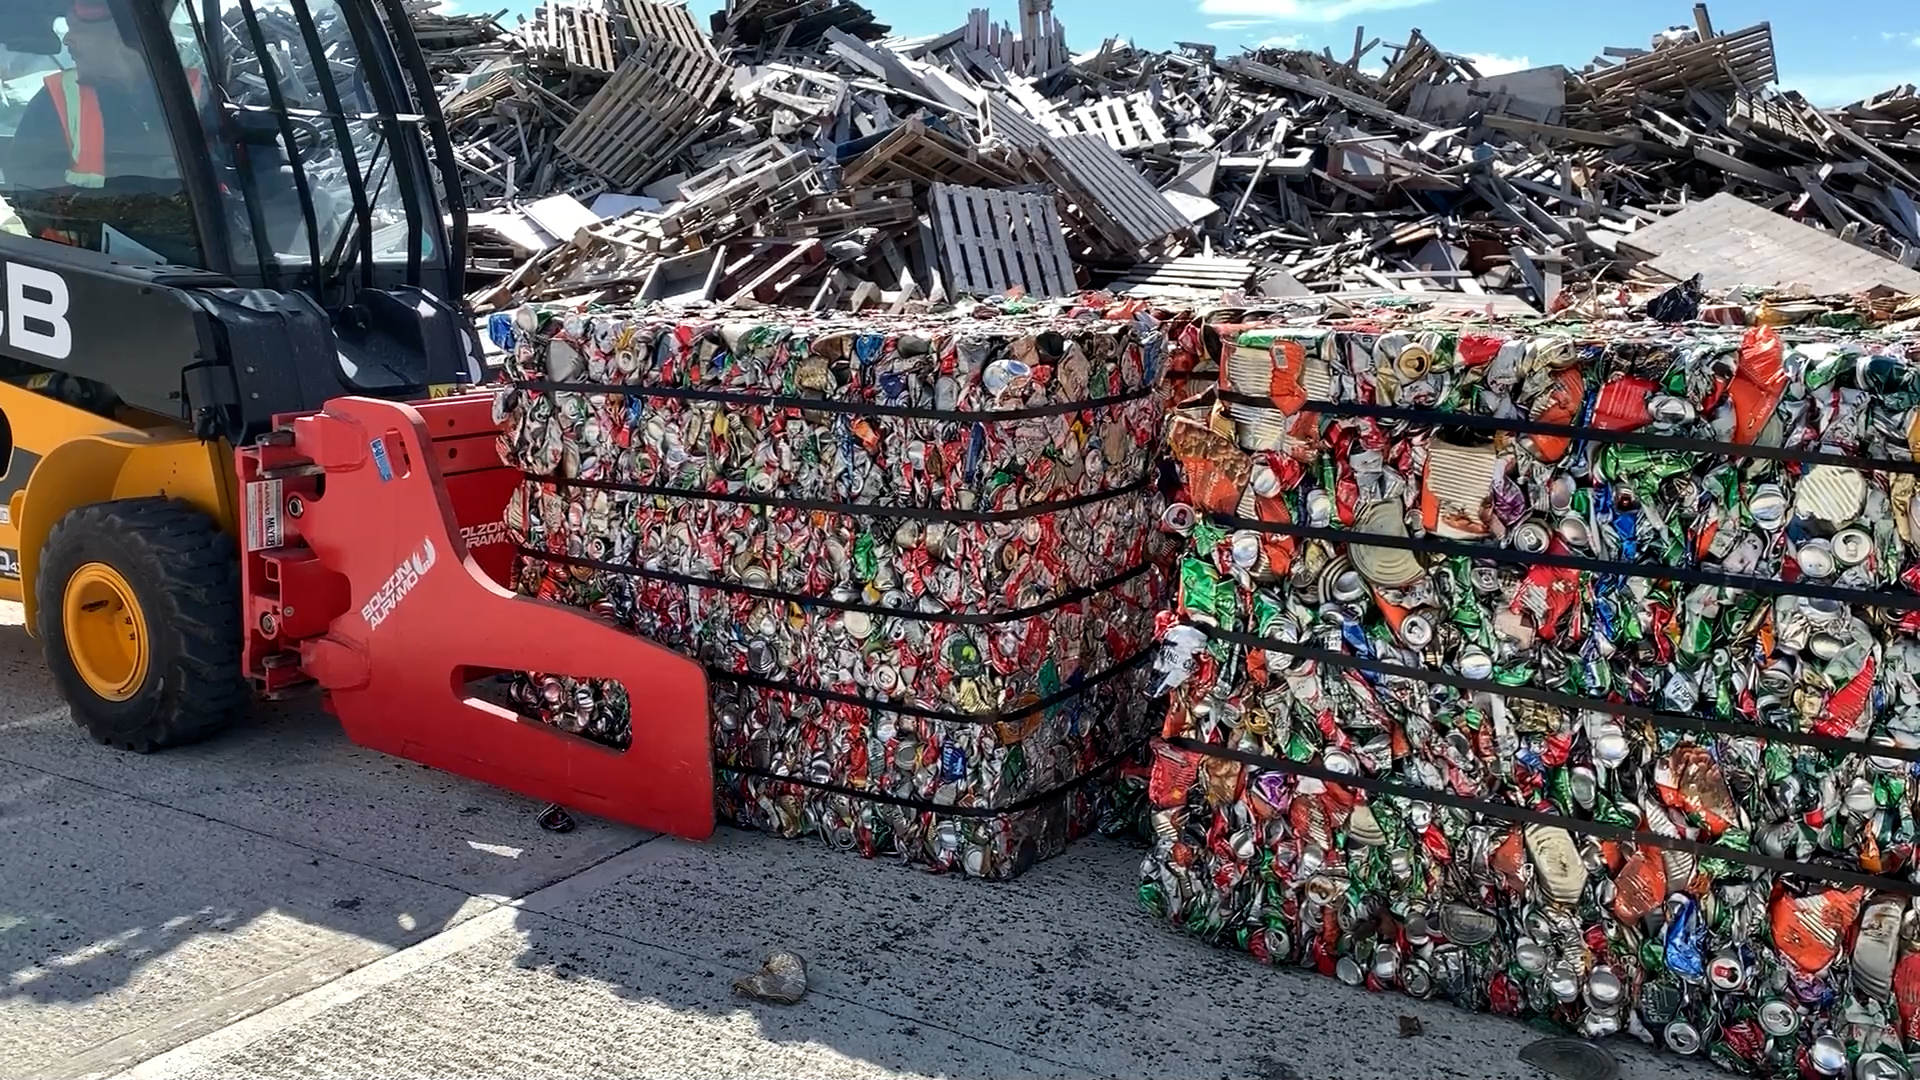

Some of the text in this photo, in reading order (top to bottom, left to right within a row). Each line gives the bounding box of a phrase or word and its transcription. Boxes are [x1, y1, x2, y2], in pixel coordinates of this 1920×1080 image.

[0, 261, 72, 359] B
[266, 517, 276, 547] MEYER
[460, 521, 507, 539] OLZON
[361, 559, 412, 622] BOLZONI
[370, 570, 419, 631] AURAMO
